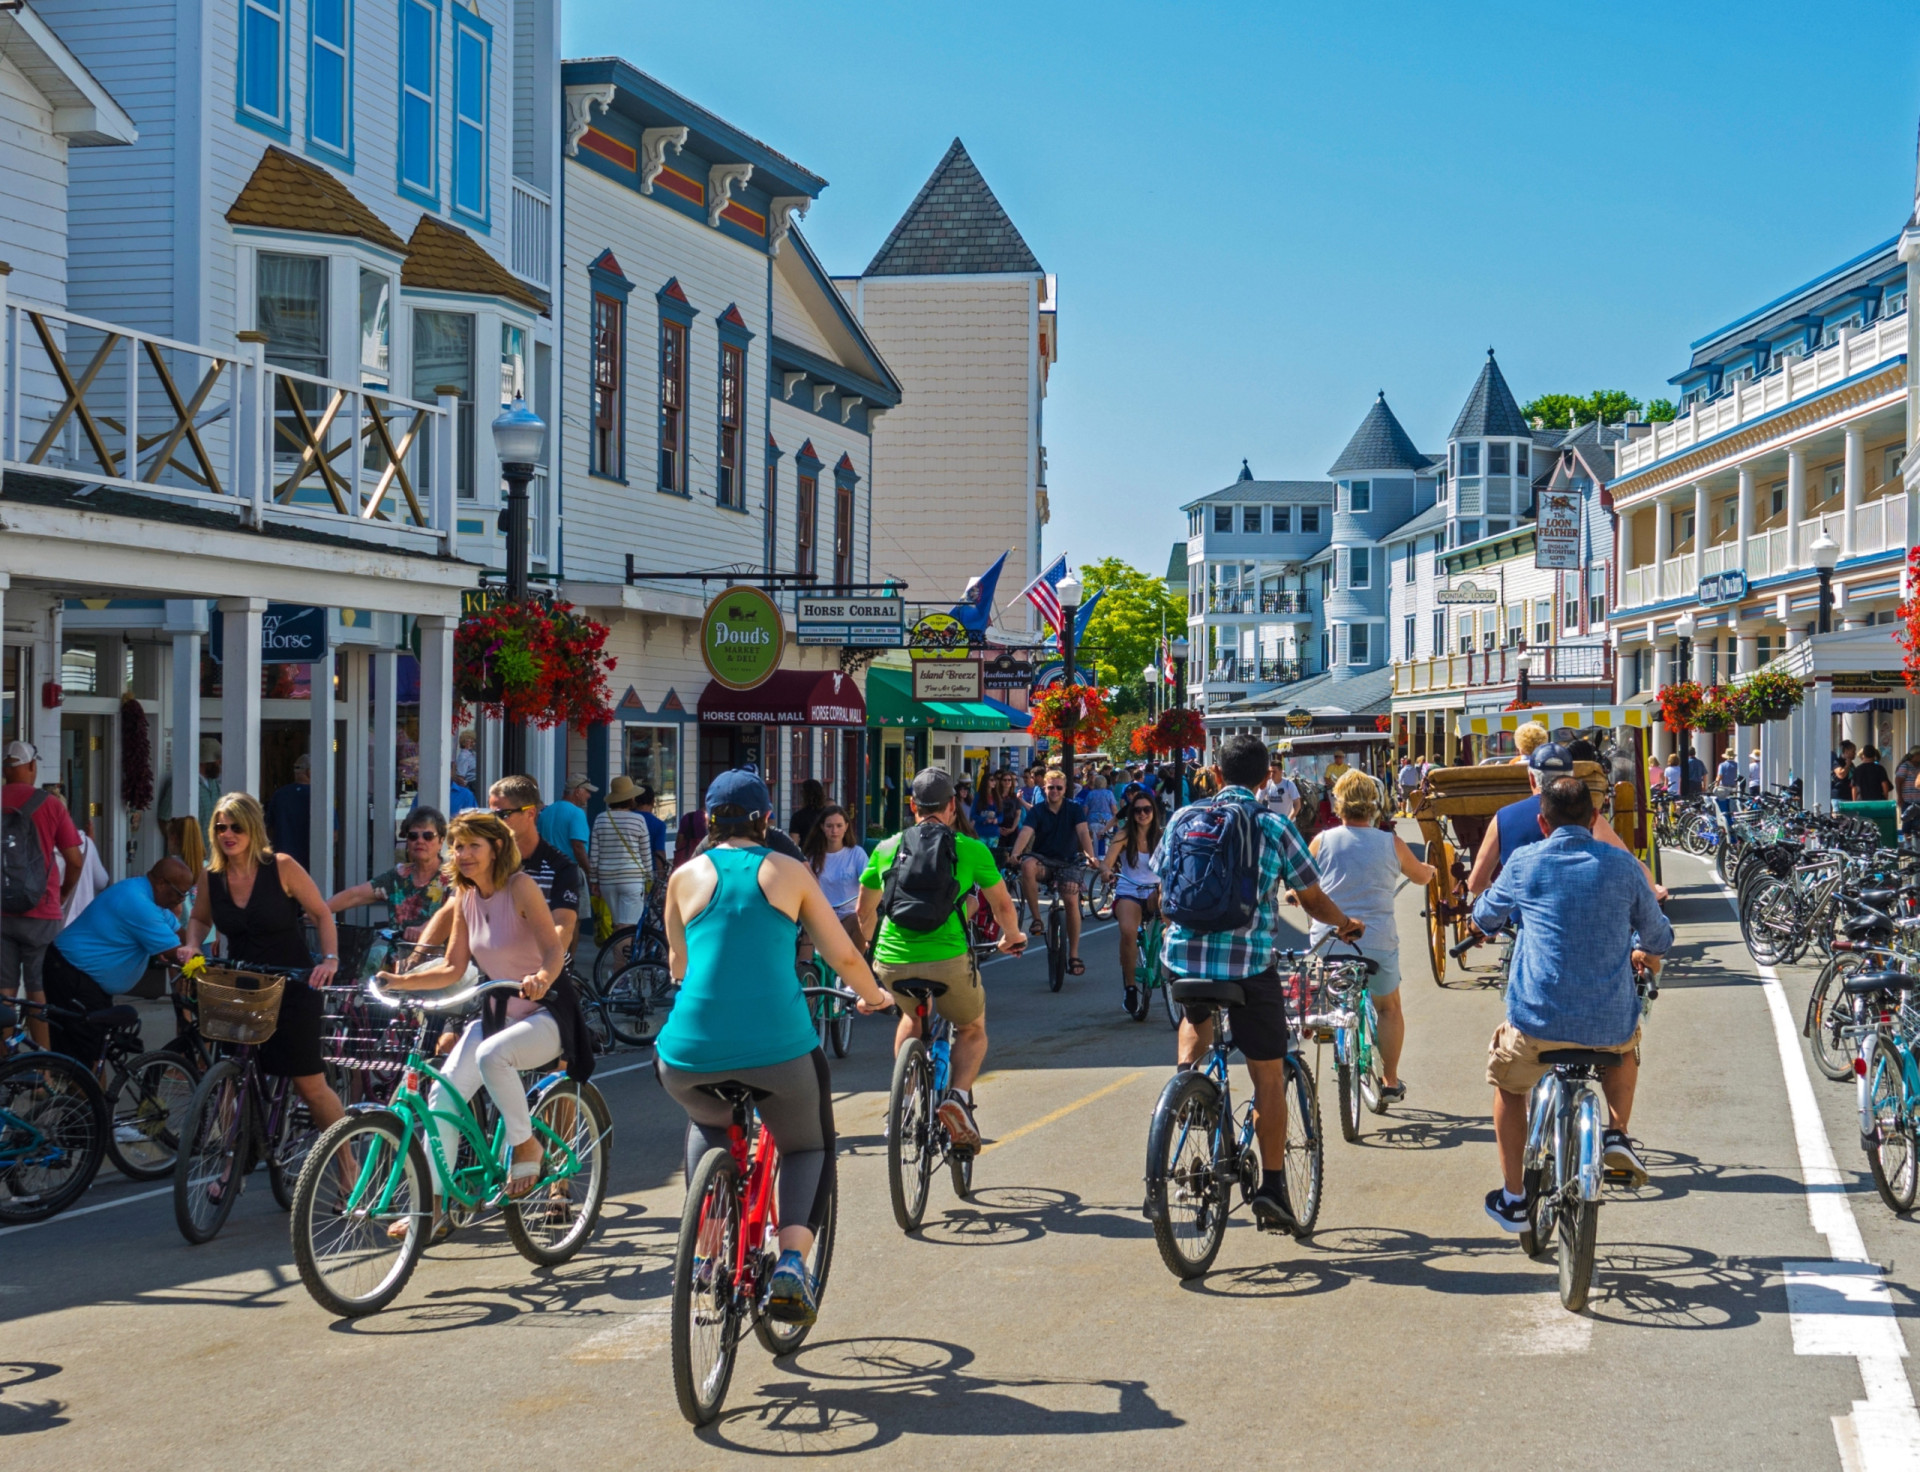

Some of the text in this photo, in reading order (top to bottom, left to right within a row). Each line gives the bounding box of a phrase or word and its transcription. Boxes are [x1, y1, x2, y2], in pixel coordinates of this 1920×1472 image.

[1546, 518, 1572, 528] LOON
[1539, 528, 1578, 537] FEATHER
[715, 622, 770, 647] Doud's
[725, 646, 760, 654] MARKET
[920, 669, 976, 680] Island Breeze
[703, 711, 804, 722] HORSE CORRAL MALL
[811, 705, 862, 723] HORSE CORRAL MALL
